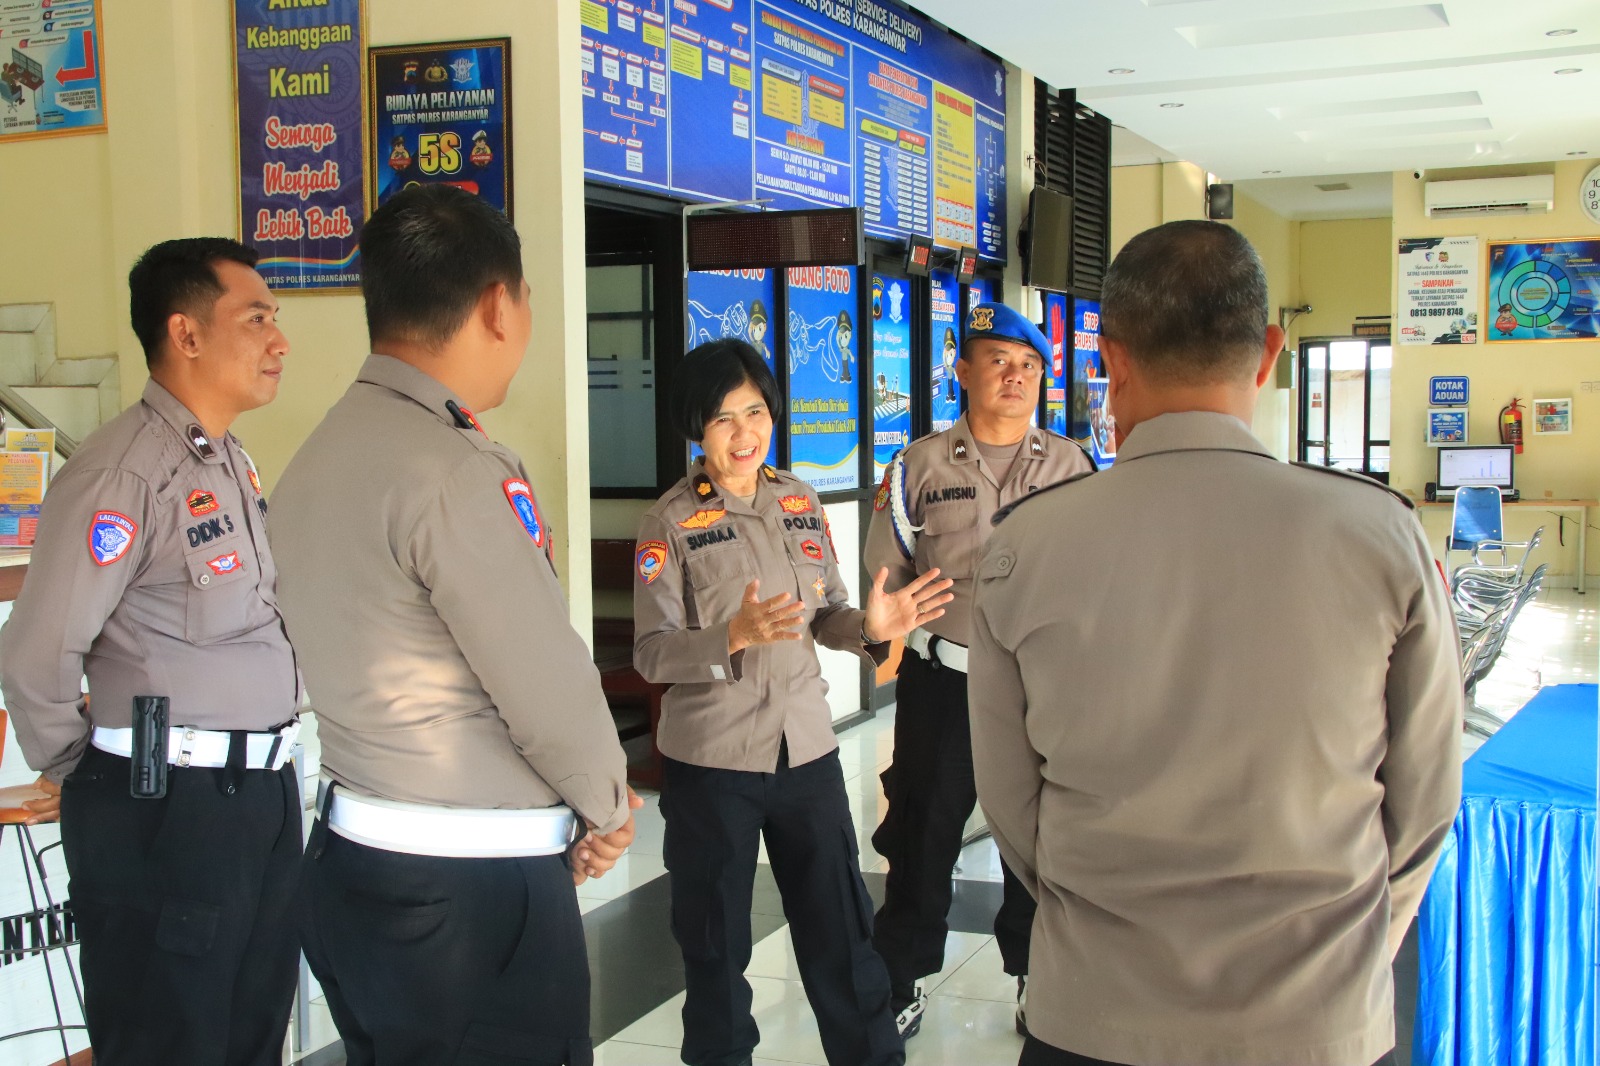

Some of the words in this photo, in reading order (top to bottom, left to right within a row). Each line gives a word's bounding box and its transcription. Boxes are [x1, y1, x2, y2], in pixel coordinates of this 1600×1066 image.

[247, 24, 352, 50] Kebanggaan
[819, 0, 851, 27] POLRES
[853, 12, 907, 53] KARANGANYAR
[889, 12, 923, 46] DELIVERY)
[269, 64, 330, 98] Kami
[386, 92, 429, 111] BUDAYA
[431, 88, 495, 109] PELAYANAN
[392, 113, 416, 125] SATPAS
[417, 112, 441, 124] POLRES
[442, 109, 489, 122] KARANGANYAR
[265, 116, 337, 152] Semoga
[418, 131, 462, 175] 5S
[263, 160, 340, 200] Menjadi
[1588, 190, 1596, 199] 9
[1591, 201, 1599, 210] 8
[254, 209, 304, 241] Lebih
[305, 206, 354, 239] Baik
[286, 275, 311, 283] POLRES
[312, 274, 360, 283] KARANGANYAR
[788, 265, 823, 291] RUANG
[823, 267, 850, 294] FOTO
[1422, 279, 1454, 288] SAMPAIKAN
[1084, 311, 1098, 330] STOP
[1410, 309, 1427, 317] 0813
[1428, 308, 1445, 316] 9897
[1446, 307, 1463, 316] 8748
[1435, 381, 1464, 390] KOTAK
[1435, 391, 1464, 400] ADUAN
[187, 517, 226, 548] DIDIK
[223, 513, 235, 533] S
[783, 516, 822, 532] POLRI
[687, 526, 737, 551] SUKMA.A
